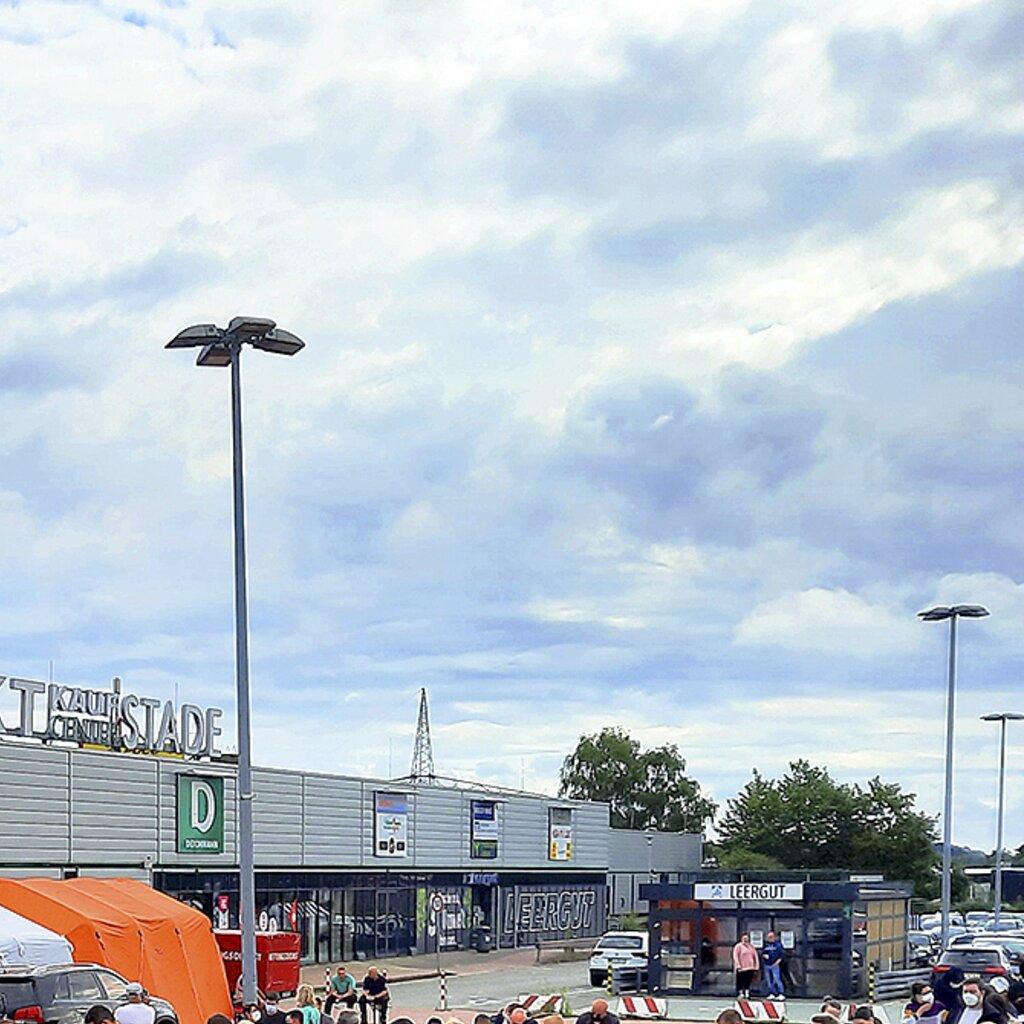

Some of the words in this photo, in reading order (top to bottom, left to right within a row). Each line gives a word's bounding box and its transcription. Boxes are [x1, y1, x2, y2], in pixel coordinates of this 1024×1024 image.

[122, 694, 223, 757] STADE
[191, 781, 215, 832] D
[504, 891, 595, 934] LEERGUT
[730, 885, 786, 899] LEERGUT
